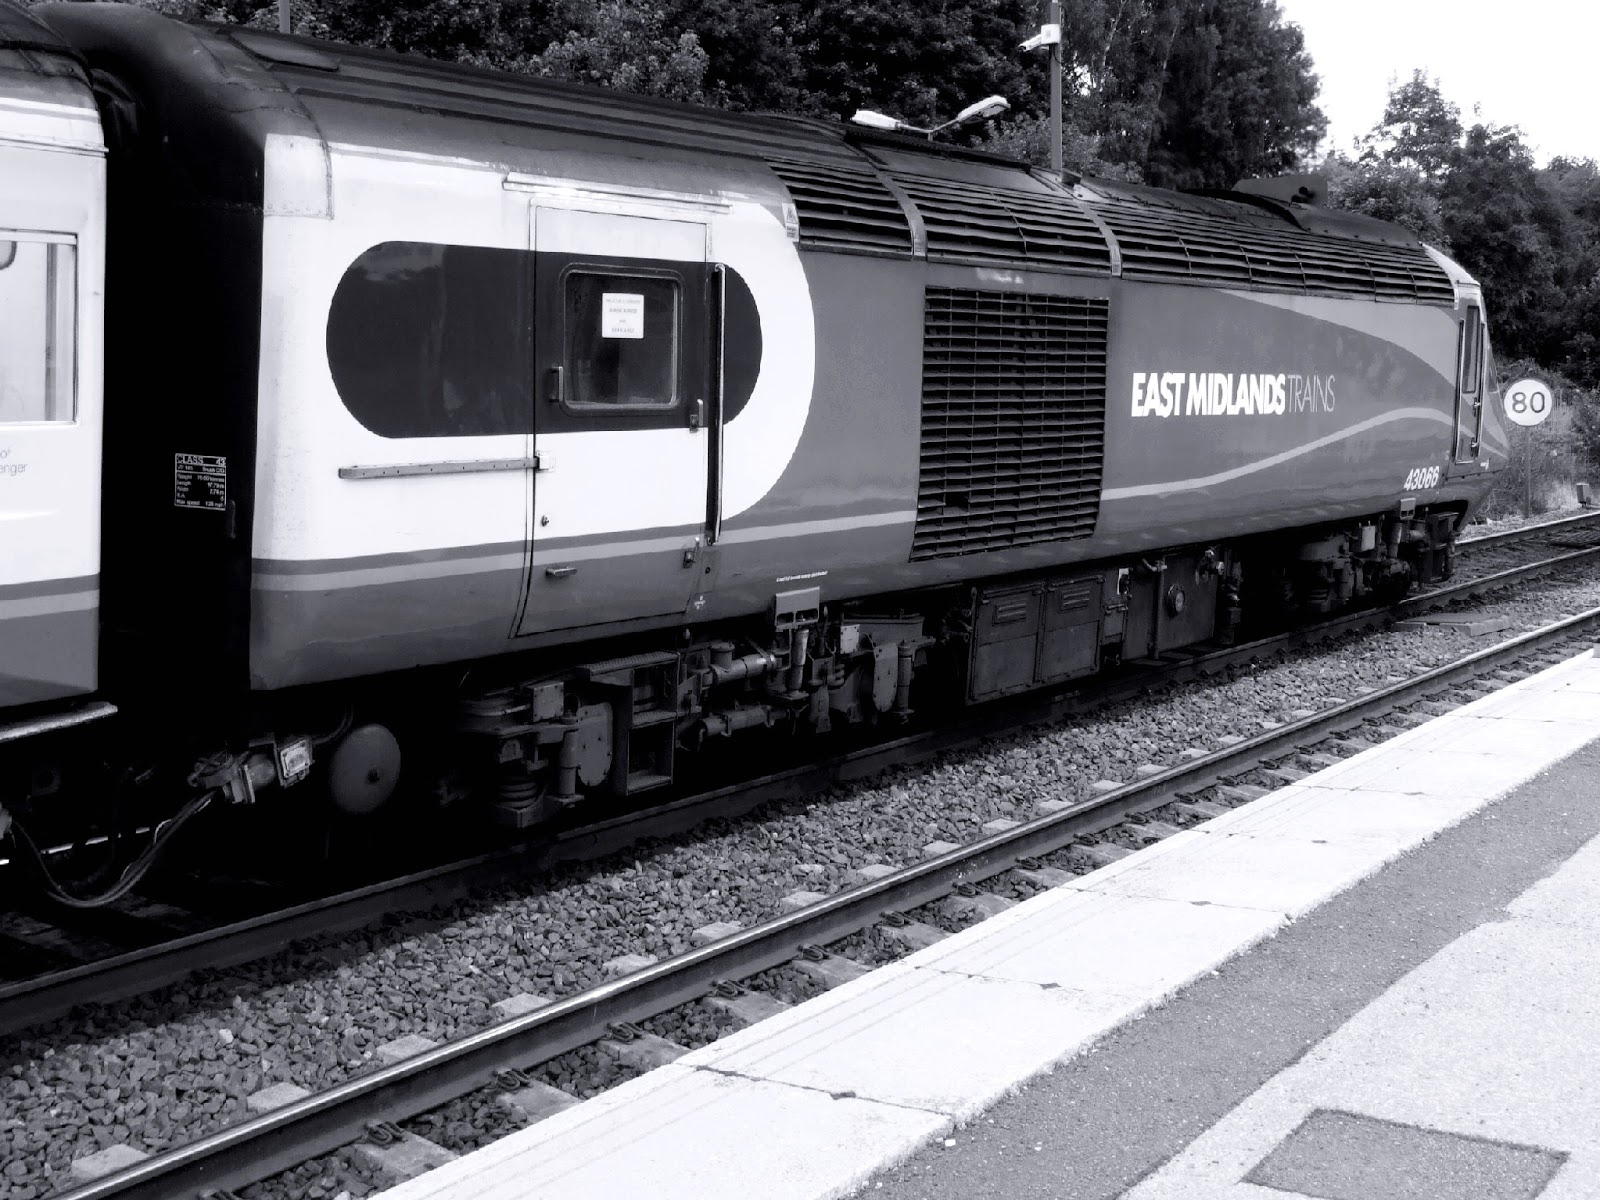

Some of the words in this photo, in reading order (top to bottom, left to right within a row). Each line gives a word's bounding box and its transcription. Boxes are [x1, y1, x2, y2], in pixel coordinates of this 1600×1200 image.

[1131, 372, 1186, 418] EAST
[1186, 372, 1286, 416] MIDLANDS
[1287, 373, 1336, 413] TRAINS
[1512, 391, 1545, 414] 80
[177, 455, 204, 465] CLASS
[215, 457, 226, 467] 43
[1403, 465, 1440, 492] 43066
